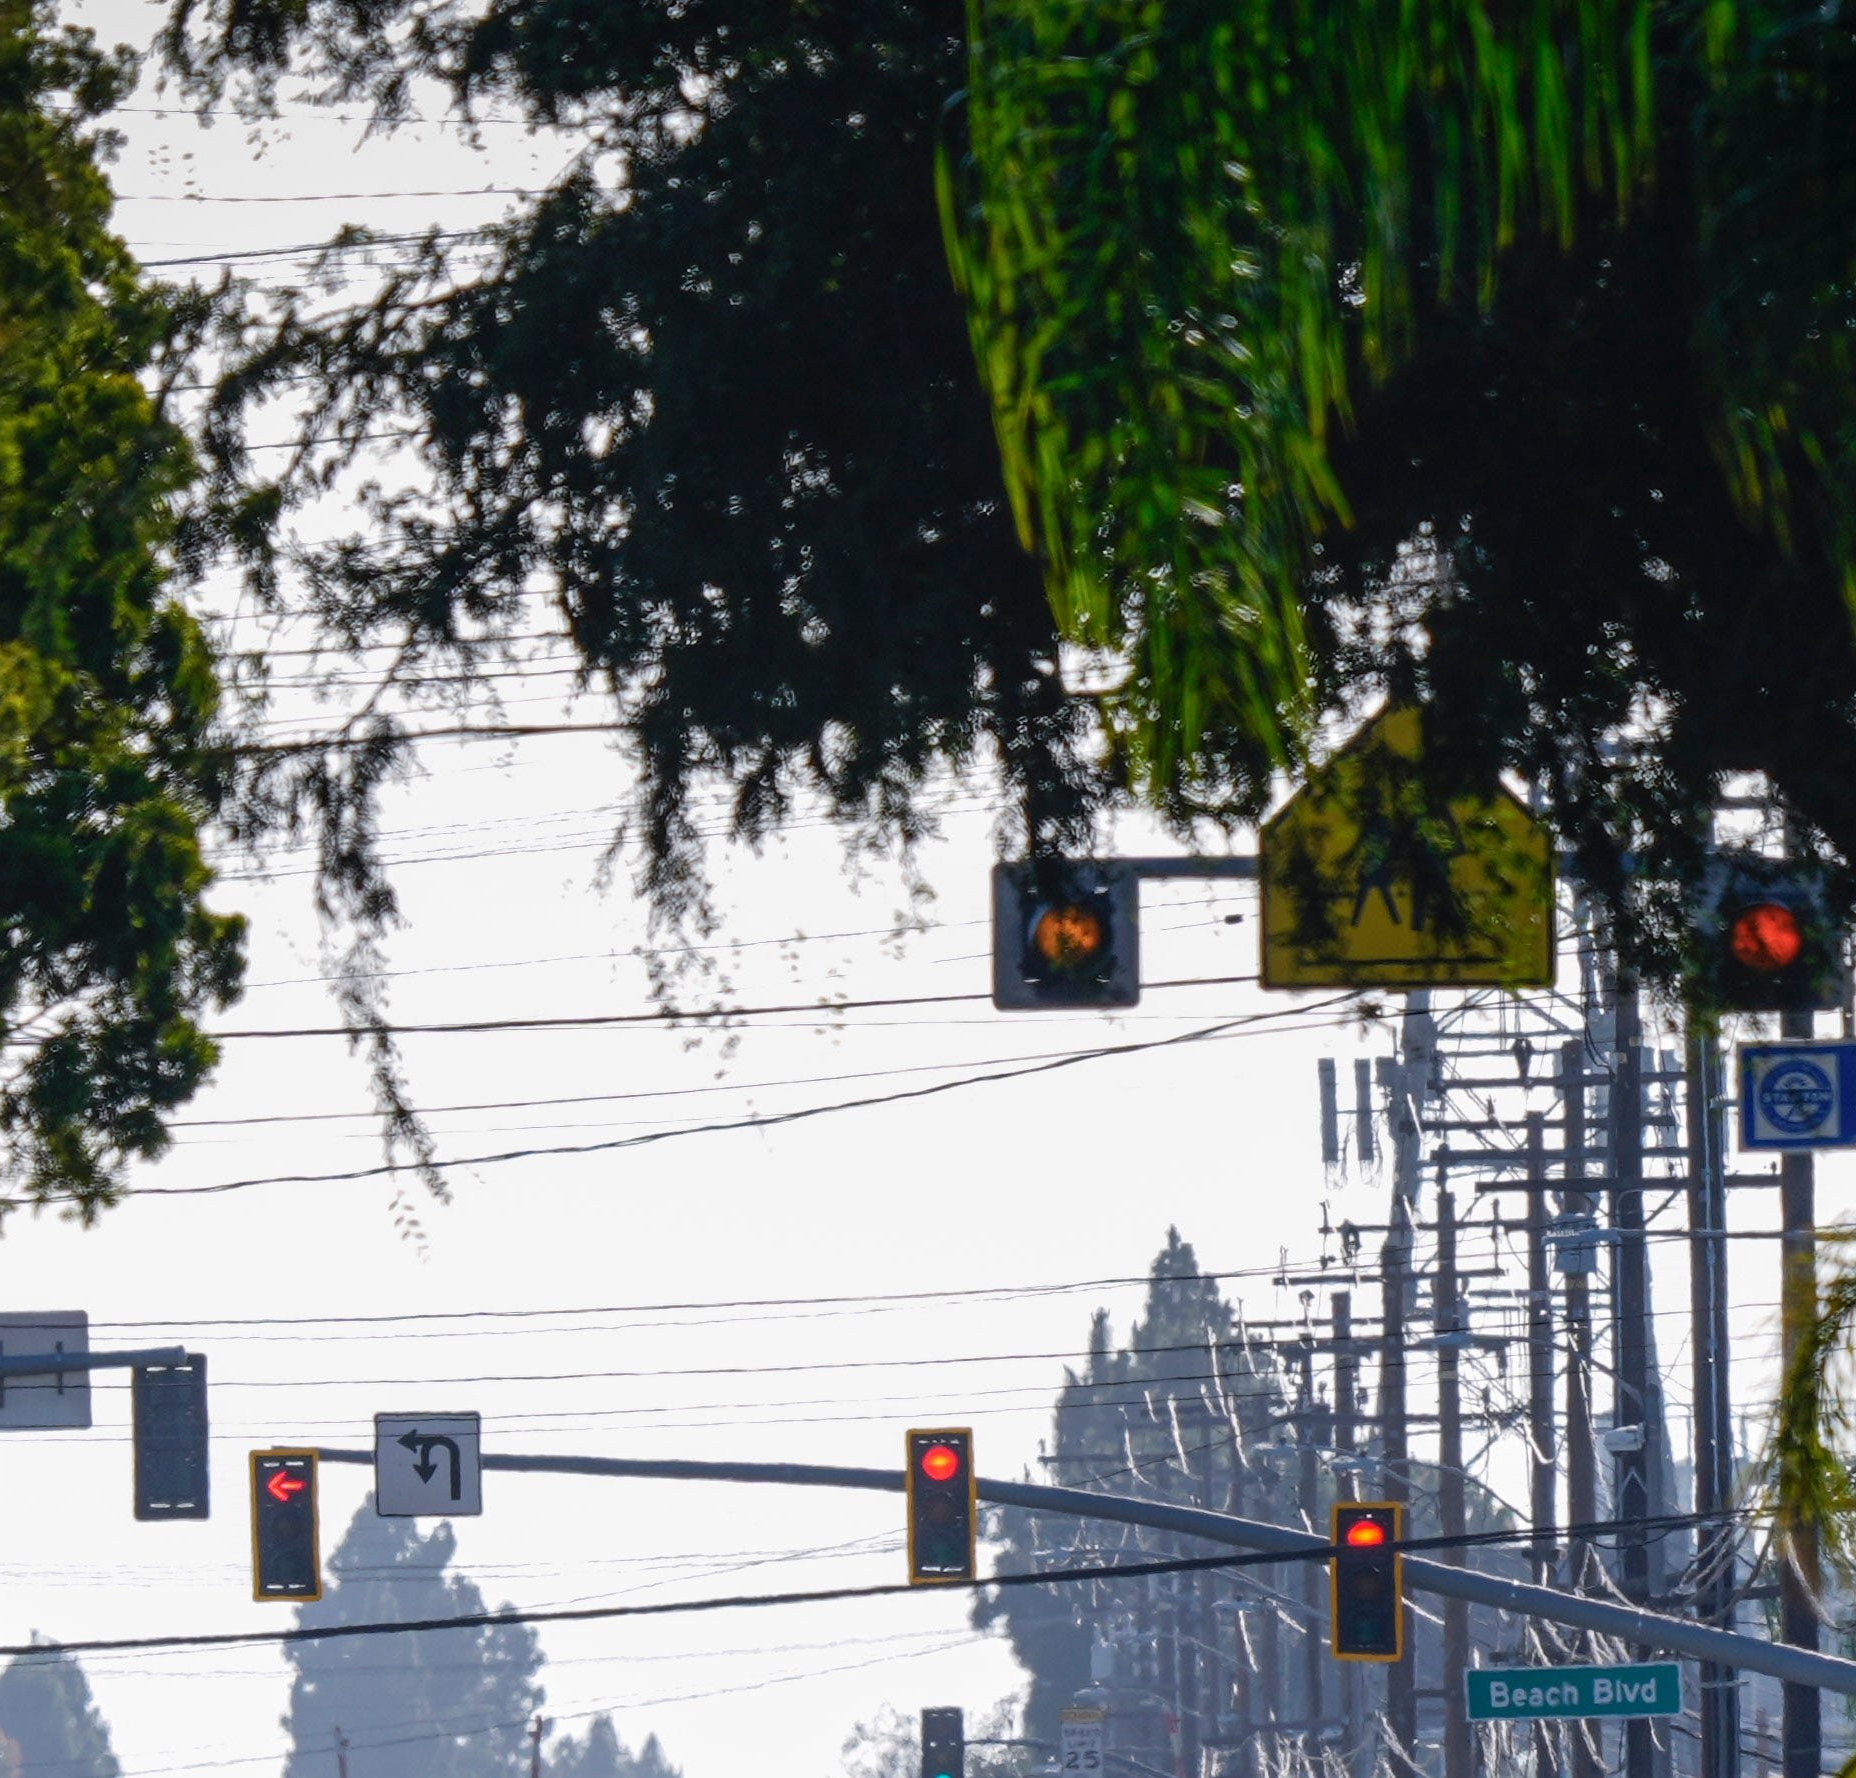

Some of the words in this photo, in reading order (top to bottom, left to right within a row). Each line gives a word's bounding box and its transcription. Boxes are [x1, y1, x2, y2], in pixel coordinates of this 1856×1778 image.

[1489, 1681, 1579, 1708] Beach
[1593, 1677, 1657, 1704] Blvd
[1065, 1750, 1100, 1769] 25
